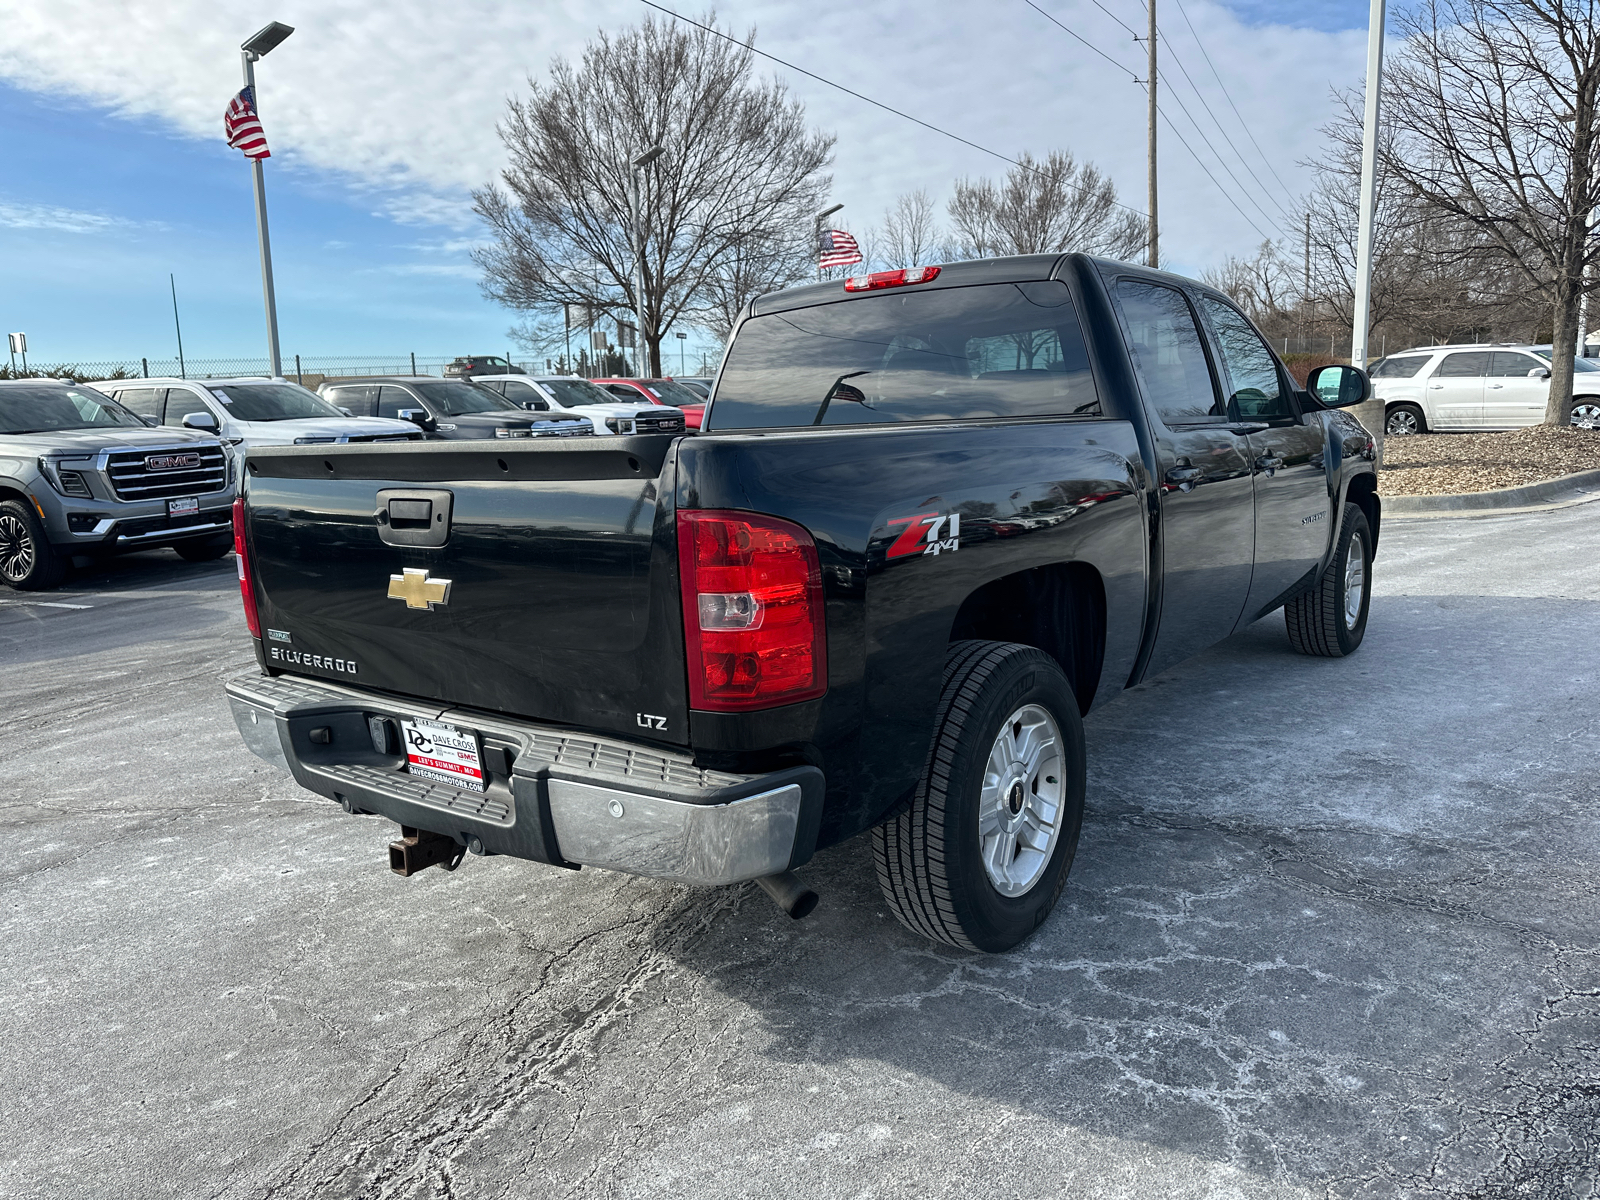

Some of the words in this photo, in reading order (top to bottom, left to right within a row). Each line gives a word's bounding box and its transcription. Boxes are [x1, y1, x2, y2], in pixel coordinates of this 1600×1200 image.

[660, 420, 678, 428] GMC
[150, 456, 199, 469] GMC
[887, 511, 960, 559] Z71
[271, 647, 357, 674] SILVERADO
[636, 713, 668, 731] LTZ
[432, 734, 452, 746] DAVE
[452, 738, 476, 751] CROSS
[417, 756, 434, 766] LEE'S
[434, 761, 463, 773] SUMMIT,
[463, 767, 475, 775] MO
[457, 751, 478, 762] GMC
[409, 766, 484, 792] DAVECROSSMOTORS.COM
